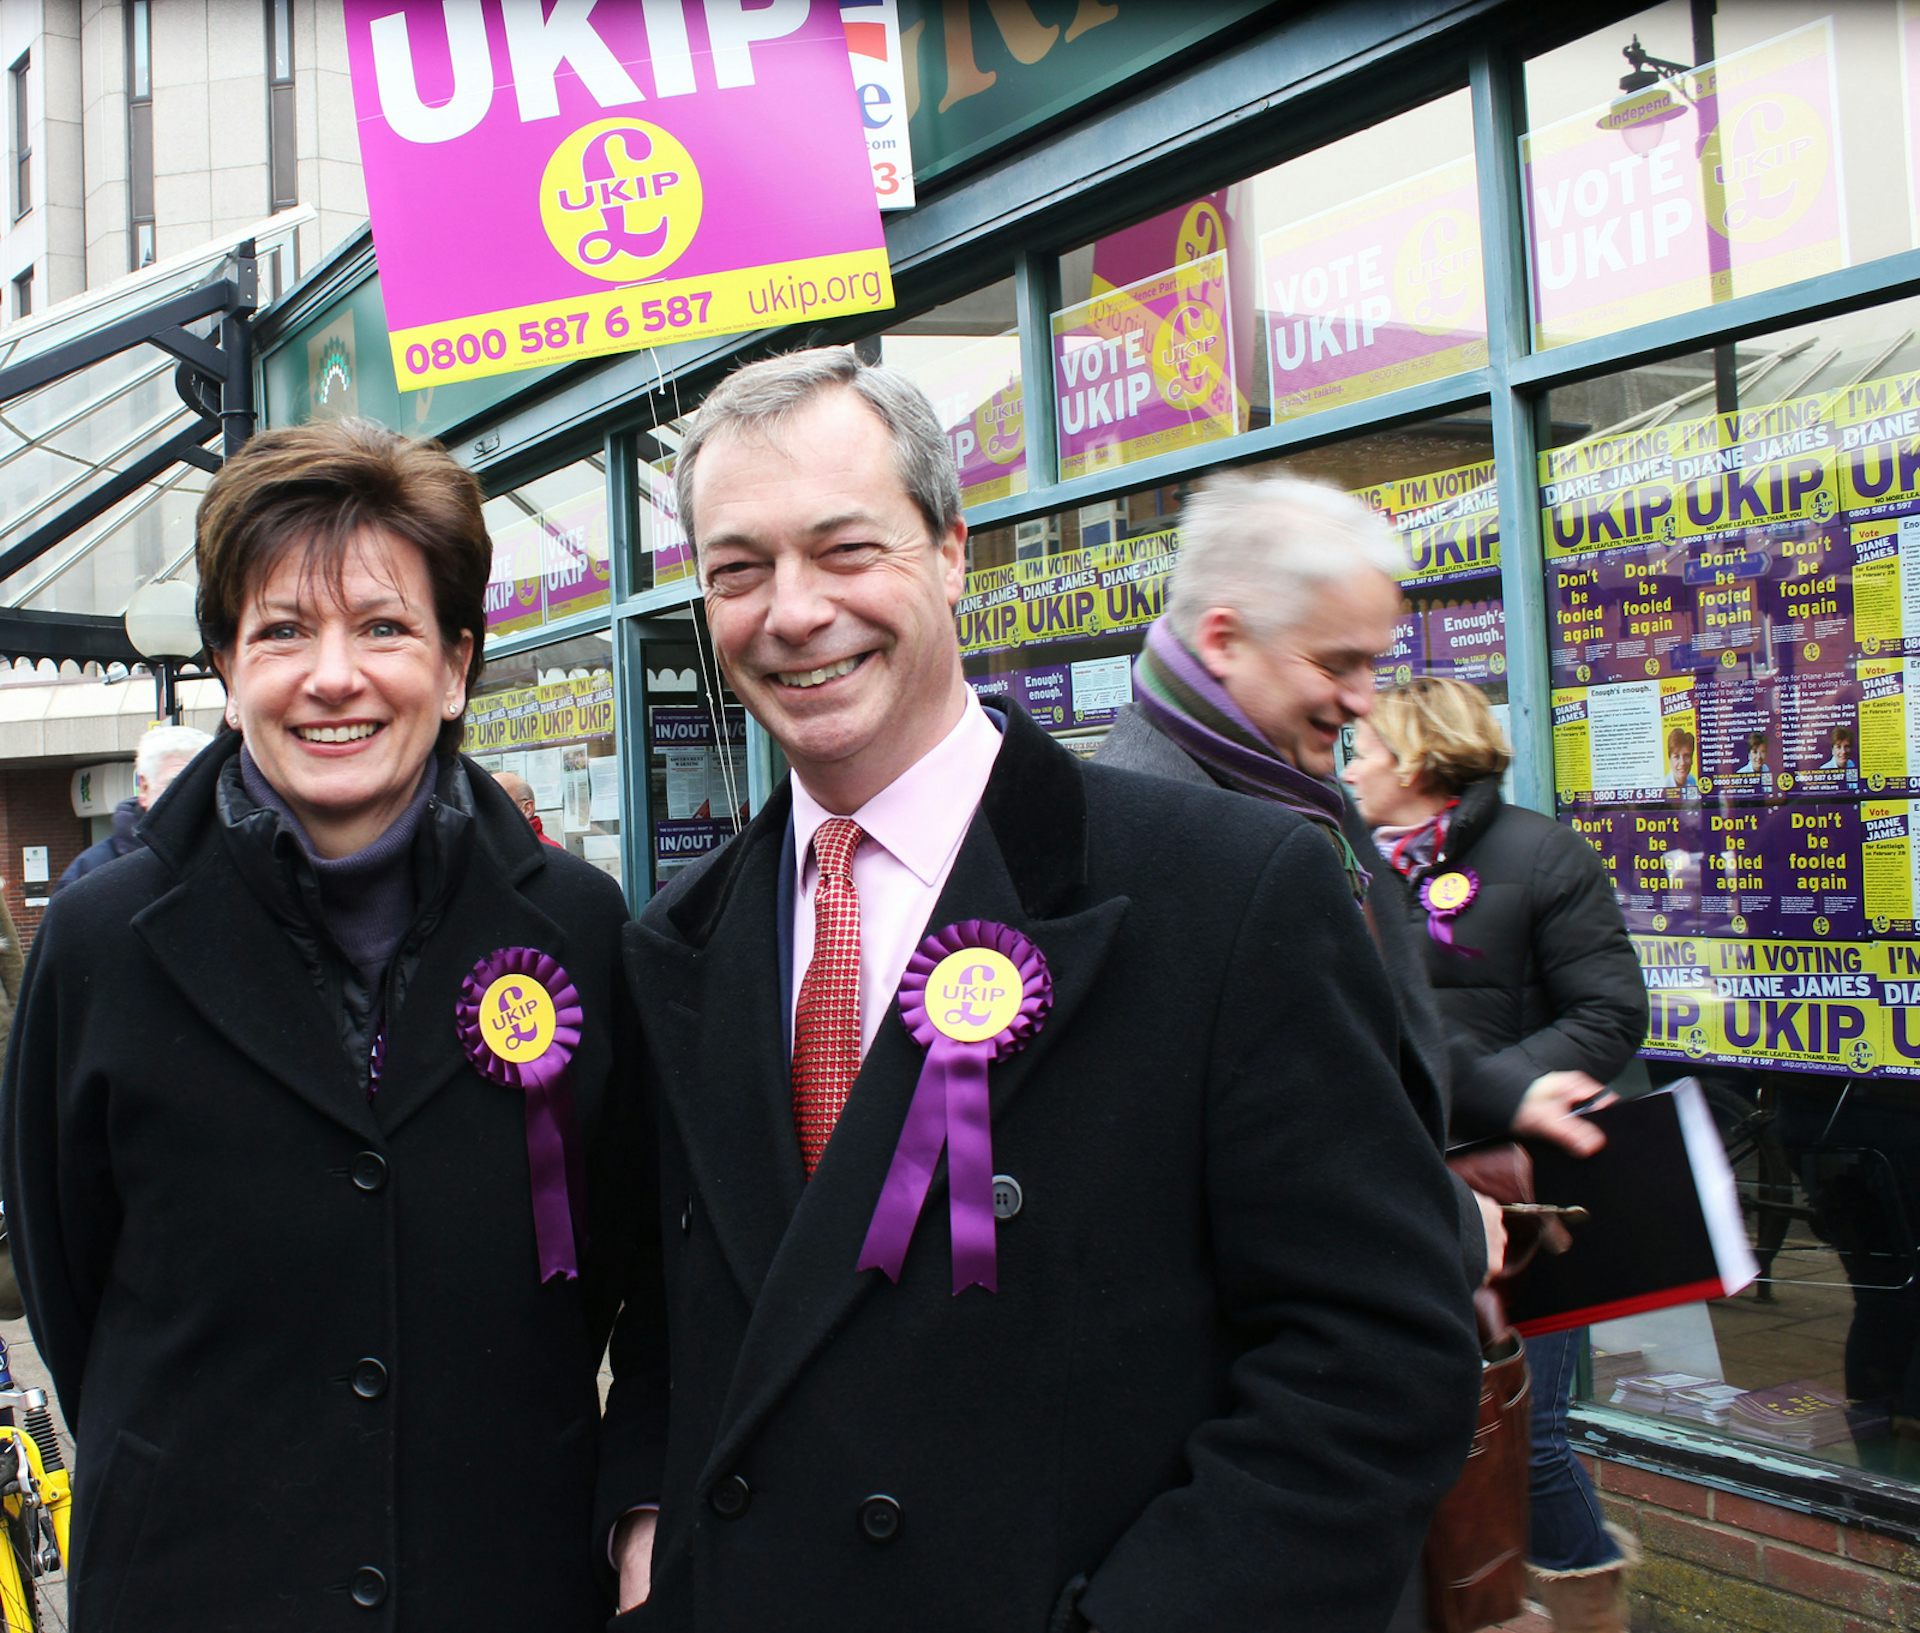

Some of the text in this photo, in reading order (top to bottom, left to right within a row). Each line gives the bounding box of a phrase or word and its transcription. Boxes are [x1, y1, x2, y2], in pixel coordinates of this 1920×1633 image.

[369, 0, 808, 144] UKIP
[558, 170, 680, 212] UKIP
[1536, 140, 1684, 230] VOTE
[1539, 198, 1692, 291] UKIP
[1274, 244, 1385, 318] VOTE
[404, 328, 507, 376] 0800
[519, 311, 590, 354] 587
[604, 305, 629, 338] 6
[641, 290, 713, 333] 587
[748, 269, 882, 317] ukip.org
[1275, 294, 1390, 372] UKIP
[1060, 329, 1146, 388] VOTE
[1162, 335, 1218, 367] UKIP
[1061, 370, 1151, 436] UKIP
[1848, 383, 1886, 418] I'M
[1683, 399, 1821, 451] I'M VOTING
[1843, 410, 1920, 452] DIANE
[1547, 430, 1669, 478] I'M VOTING
[1678, 426, 1829, 482] DIANE JAMES
[1545, 455, 1672, 506] DIANE JAMES
[1400, 480, 1427, 506] I'M
[1686, 458, 1825, 526] UKIP
[1396, 504, 1448, 531] DIANE
[1552, 485, 1672, 549] UKIP
[1767, 514, 1788, 522] THANK
[1848, 501, 1912, 518] 0800 587 597
[1402, 514, 1500, 571] UKIP
[1683, 530, 1740, 544] 0800 587 597
[1859, 529, 1880, 538] Vote
[1105, 532, 1180, 566] I'M VOTING
[1781, 536, 1832, 558] Don't
[1855, 537, 1891, 554] DIANE
[1856, 547, 1895, 564] JAMES
[1025, 551, 1092, 580] I'M VOTING
[1700, 548, 1746, 568] Don't
[1797, 559, 1819, 575] be
[547, 553, 588, 591] UKIP
[1102, 565, 1141, 587] DIANE
[1624, 559, 1668, 578] Don't
[1715, 570, 1735, 586] be
[973, 566, 1014, 592] VOTING
[1022, 570, 1097, 601] DIANE JAMES
[1557, 569, 1599, 589] Don't
[1639, 581, 1657, 596] be
[1779, 576, 1836, 597] fooled
[985, 584, 1019, 606] JAMES
[1571, 590, 1588, 606] be
[1698, 587, 1751, 607] fooled
[1027, 591, 1094, 634] UKIP
[1557, 605, 1603, 625] fooled
[1623, 597, 1672, 617] fooled
[1787, 598, 1837, 619] again
[956, 604, 1017, 646] UKIP
[1444, 609, 1505, 632] Enough's
[1630, 617, 1673, 637] again
[1706, 607, 1752, 629] again
[1450, 628, 1504, 648] enough.
[1563, 625, 1604, 645] again
[1470, 654, 1488, 663] UKIP
[1025, 672, 1064, 688] Enough's
[1774, 671, 1845, 683] Vote Diane James
[1864, 666, 1885, 675] Vote
[972, 679, 1009, 695] Enough's
[1591, 685, 1652, 697] Enough's enough.
[1661, 685, 1677, 693] Vote
[1720, 679, 1759, 688] Diane James
[1817, 681, 1838, 690] voting
[1863, 674, 1897, 690] DIANE
[1863, 683, 1901, 700] JAMES
[1029, 687, 1063, 702] enough.
[1663, 691, 1689, 705] DIANE
[579, 703, 611, 730] UKIP
[1555, 702, 1582, 715] DIANE
[1555, 711, 1586, 724] JAMES
[1663, 700, 1693, 715] JAMES
[510, 716, 538, 740] UKIP
[543, 710, 573, 735] UKIP
[655, 723, 710, 740] IN/OUT
[478, 721, 505, 745] UKIP
[1713, 778, 1730, 786] 0800
[1749, 777, 1760, 785] 587
[1795, 774, 1813, 782] 0800
[1814, 773, 1826, 781] 587
[1832, 772, 1844, 781] 587
[1594, 788, 1663, 800] 0800 587 6 587
[1710, 814, 1758, 831] Don't
[1791, 811, 1842, 829] Don't
[1869, 808, 1889, 817] Vote
[1571, 817, 1613, 833] Don't
[1636, 817, 1680, 833] Don't
[1865, 816, 1900, 832] DIANE
[1866, 826, 1905, 841] JAMES
[660, 834, 714, 852] IN/OUT
[1649, 836, 1667, 851] be
[1726, 834, 1745, 850] be
[1807, 832, 1829, 849] be
[1875, 842, 1904, 851] Eastleigh
[1708, 854, 1763, 870] fooled
[1789, 853, 1846, 870] fooled
[1640, 873, 1684, 892] again
[1716, 873, 1763, 893] again
[1797, 873, 1847, 893] again
[1720, 944, 1862, 974] I'M VOTING
[942, 984, 1005, 1002] UKIP
[1717, 976, 1872, 998] DIANE JAMES
[492, 1000, 538, 1030] UKIP
[1724, 1000, 1865, 1055] UKIP
[1737, 1056, 1752, 1064] 587
[1760, 1058, 1775, 1066] 597
[1769, 1051, 1802, 1059] LEAFLETS,
[1885, 1066, 1908, 1075] 0800
